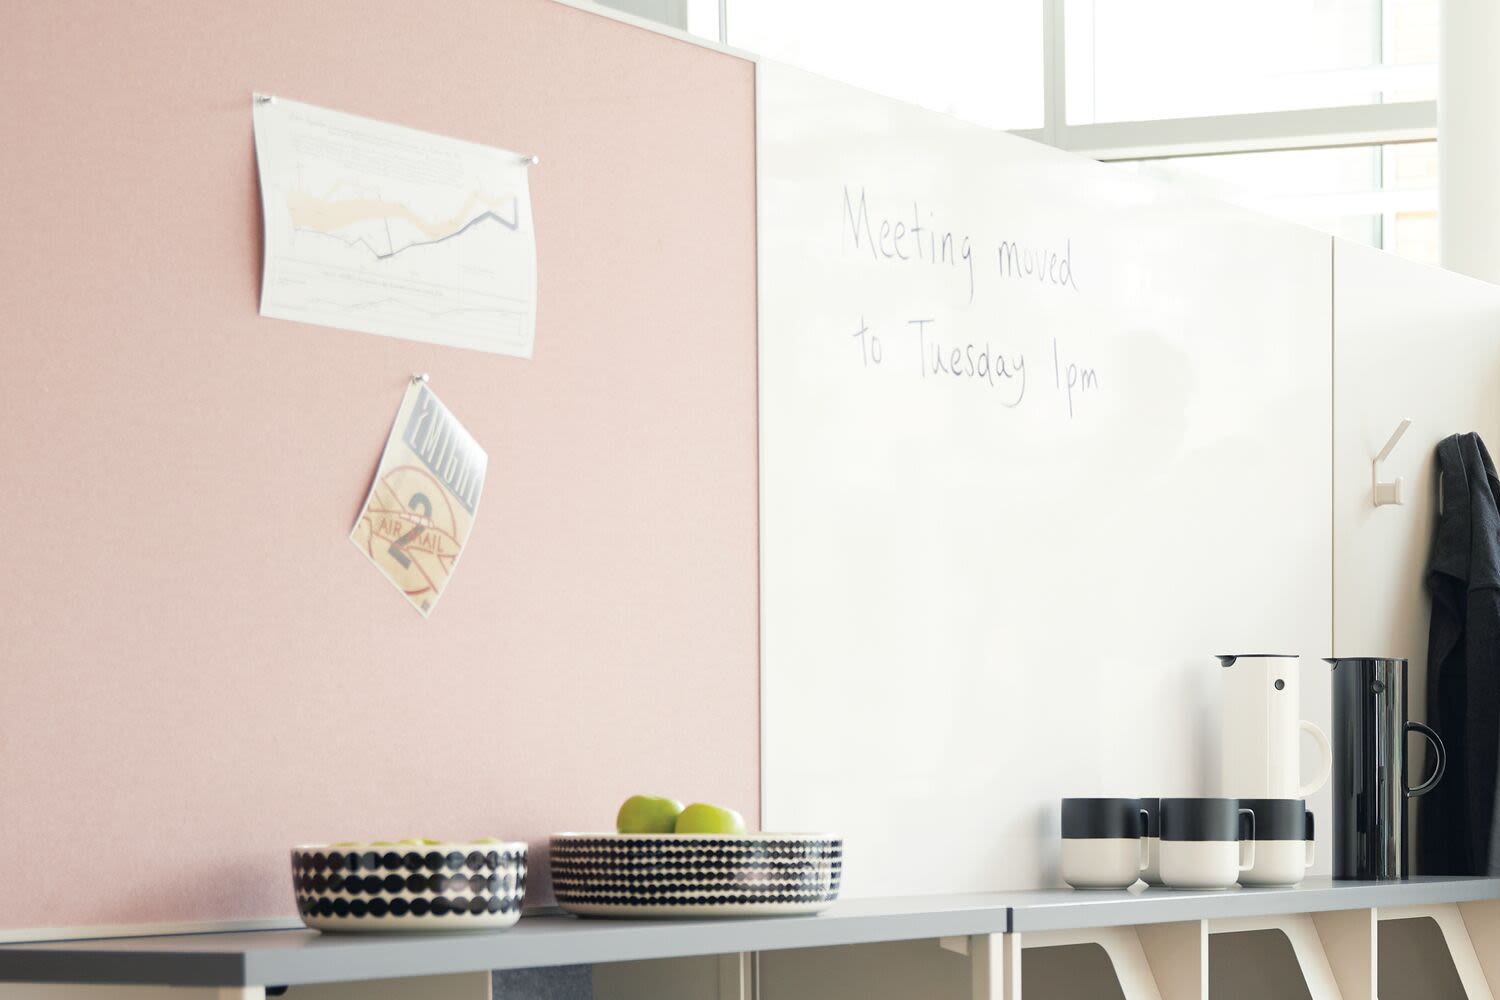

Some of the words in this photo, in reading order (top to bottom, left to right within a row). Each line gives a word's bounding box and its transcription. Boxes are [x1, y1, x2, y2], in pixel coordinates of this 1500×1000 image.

[842, 184, 974, 304] Meeting
[998, 238, 1079, 292] moved
[852, 314, 883, 367] to
[907, 318, 1026, 408] Tuesday
[1053, 336, 1098, 419] 1pm
[379, 517, 402, 537] AIR
[388, 491, 433, 570] 2
